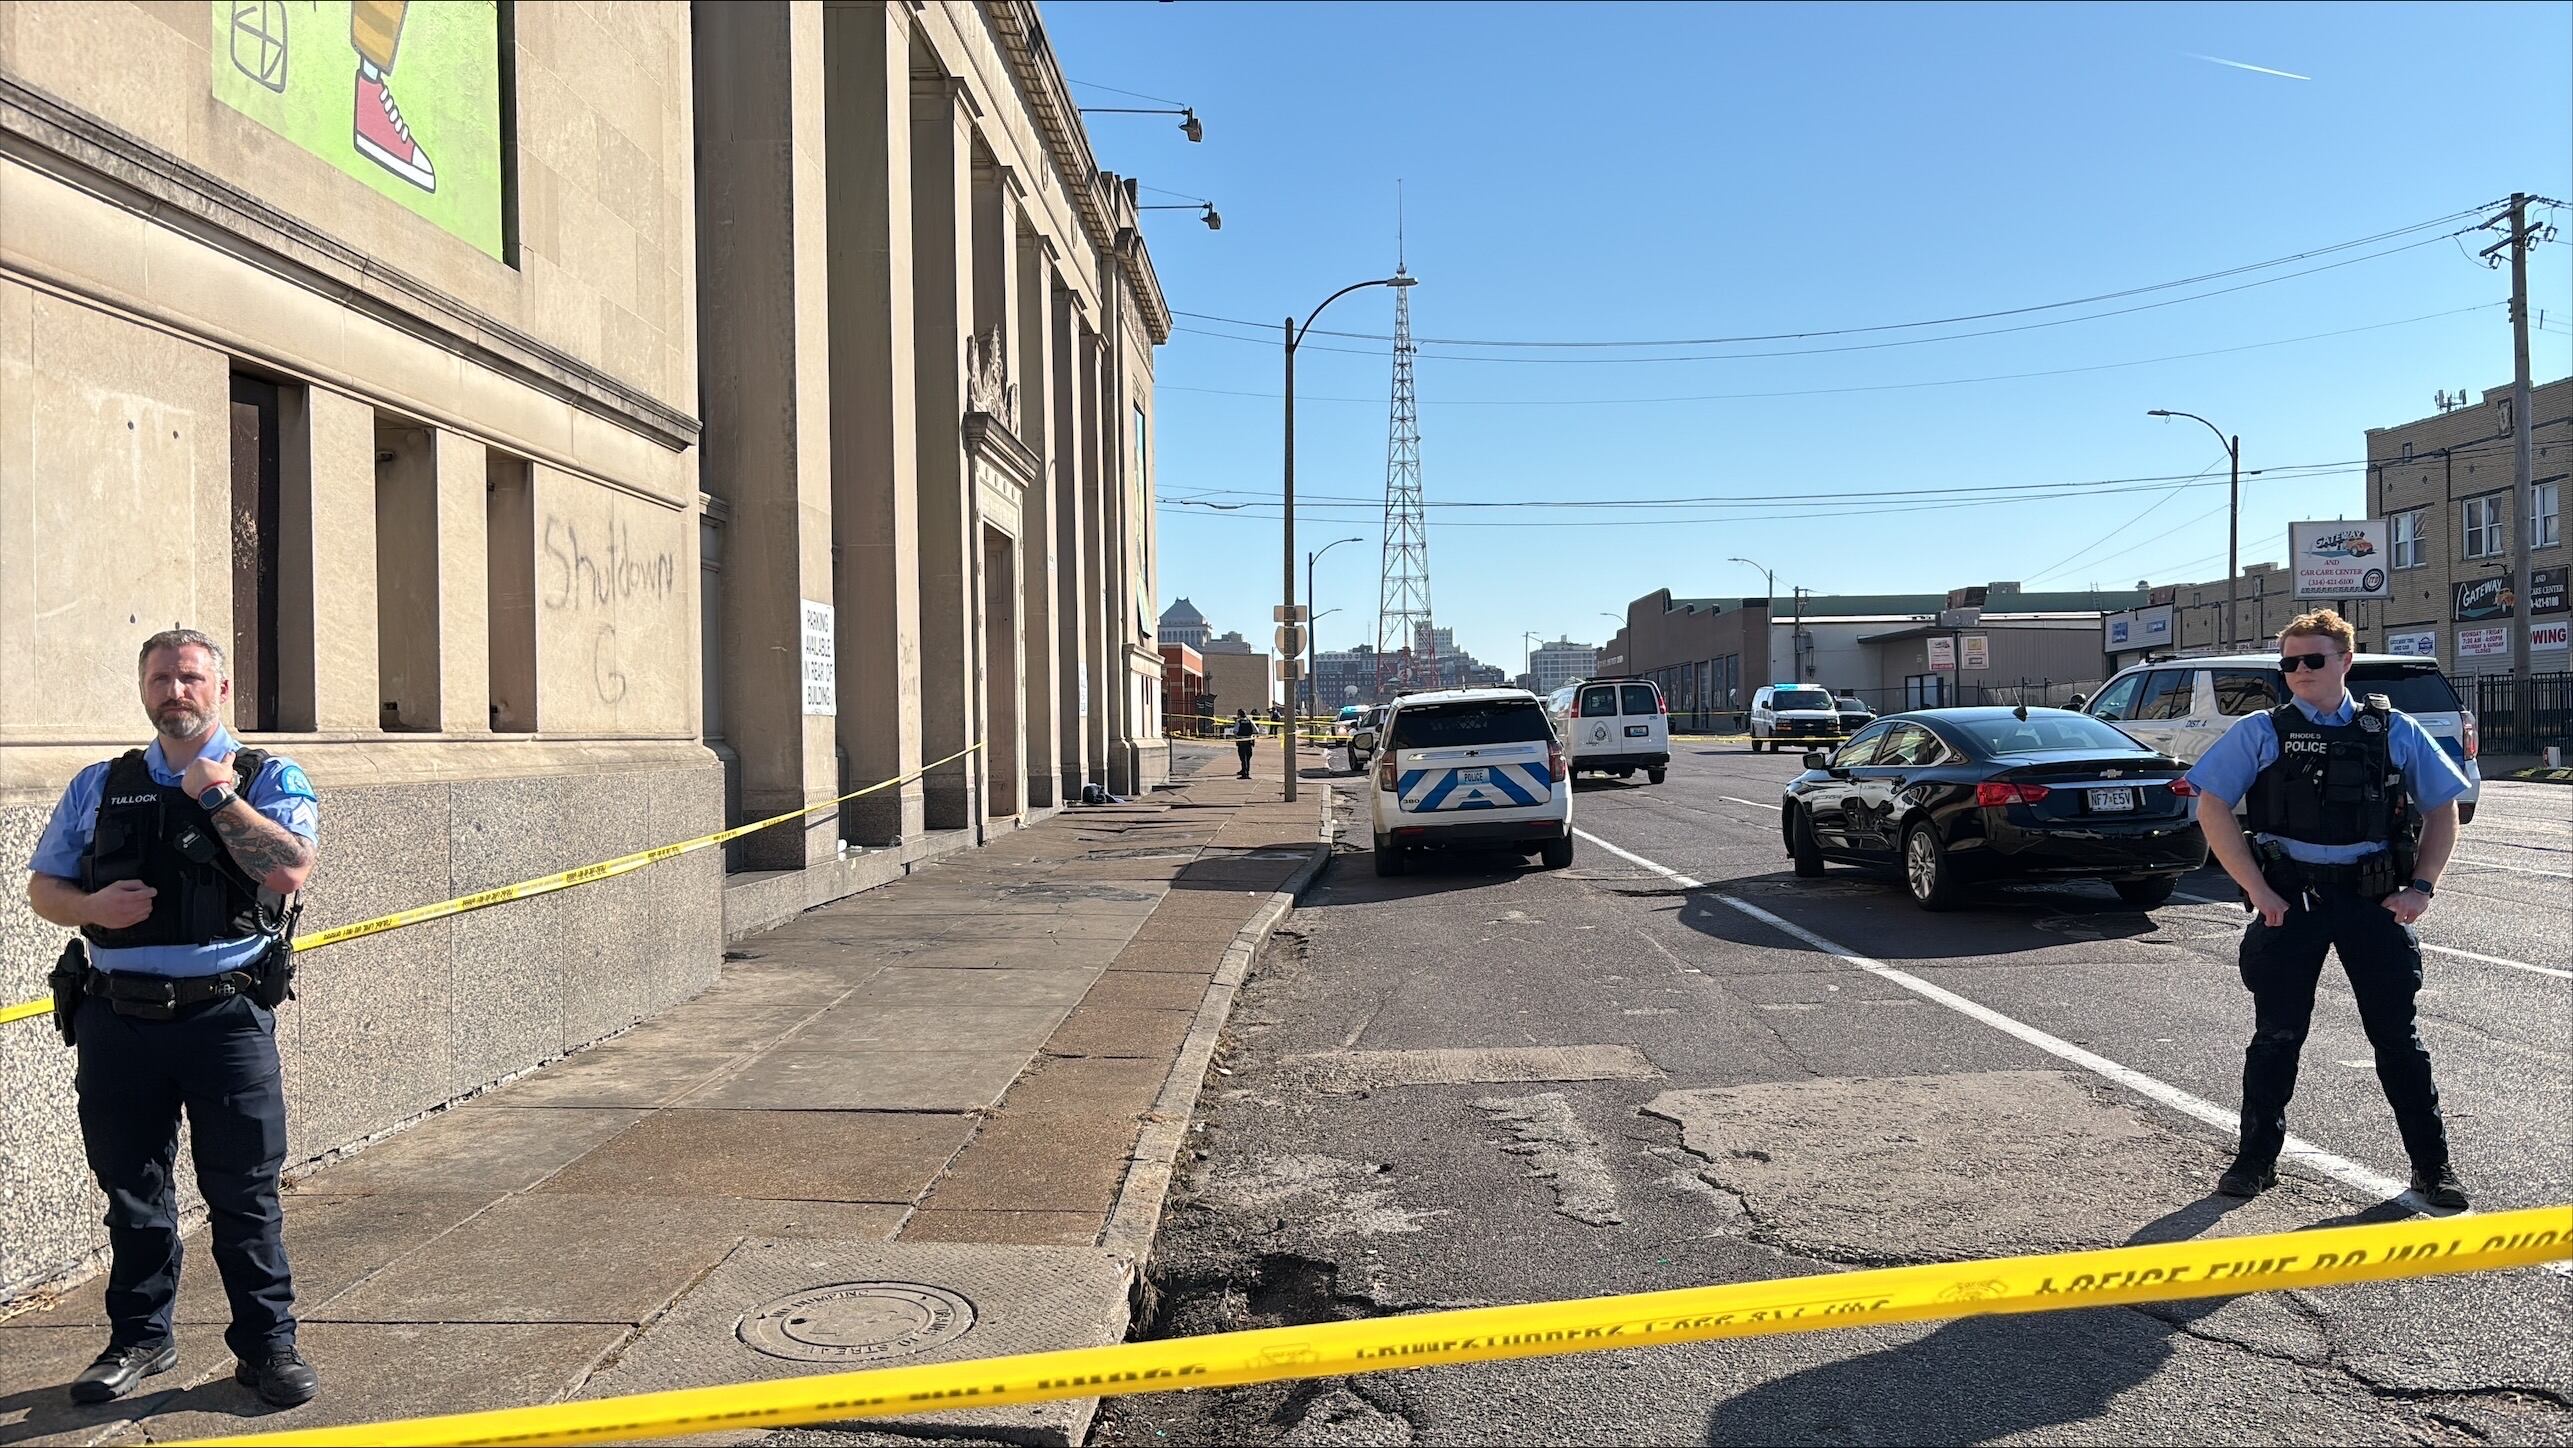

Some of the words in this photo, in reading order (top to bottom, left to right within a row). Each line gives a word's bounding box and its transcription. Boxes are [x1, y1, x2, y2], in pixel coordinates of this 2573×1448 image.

[2315, 530, 2366, 549] GATEWAY
[544, 513, 673, 611] Shutdown
[2300, 569, 2315, 577] CAR
[2335, 568, 2364, 576] CENTER
[2534, 574, 2547, 583] AND
[2462, 579, 2503, 608] GATEWAY
[2542, 584, 2565, 594] CENTER
[806, 609, 829, 633] PARKING
[2530, 627, 2566, 645] WING
[805, 634, 831, 658] AVAILABLE
[804, 659, 810, 680] IN
[811, 661, 825, 682] REAR
[2289, 732, 2322, 740] RHODES
[2284, 740, 2328, 755] POLICE
[1463, 772, 1483, 783] POLICE
[110, 793, 158, 805] TULLOCK
